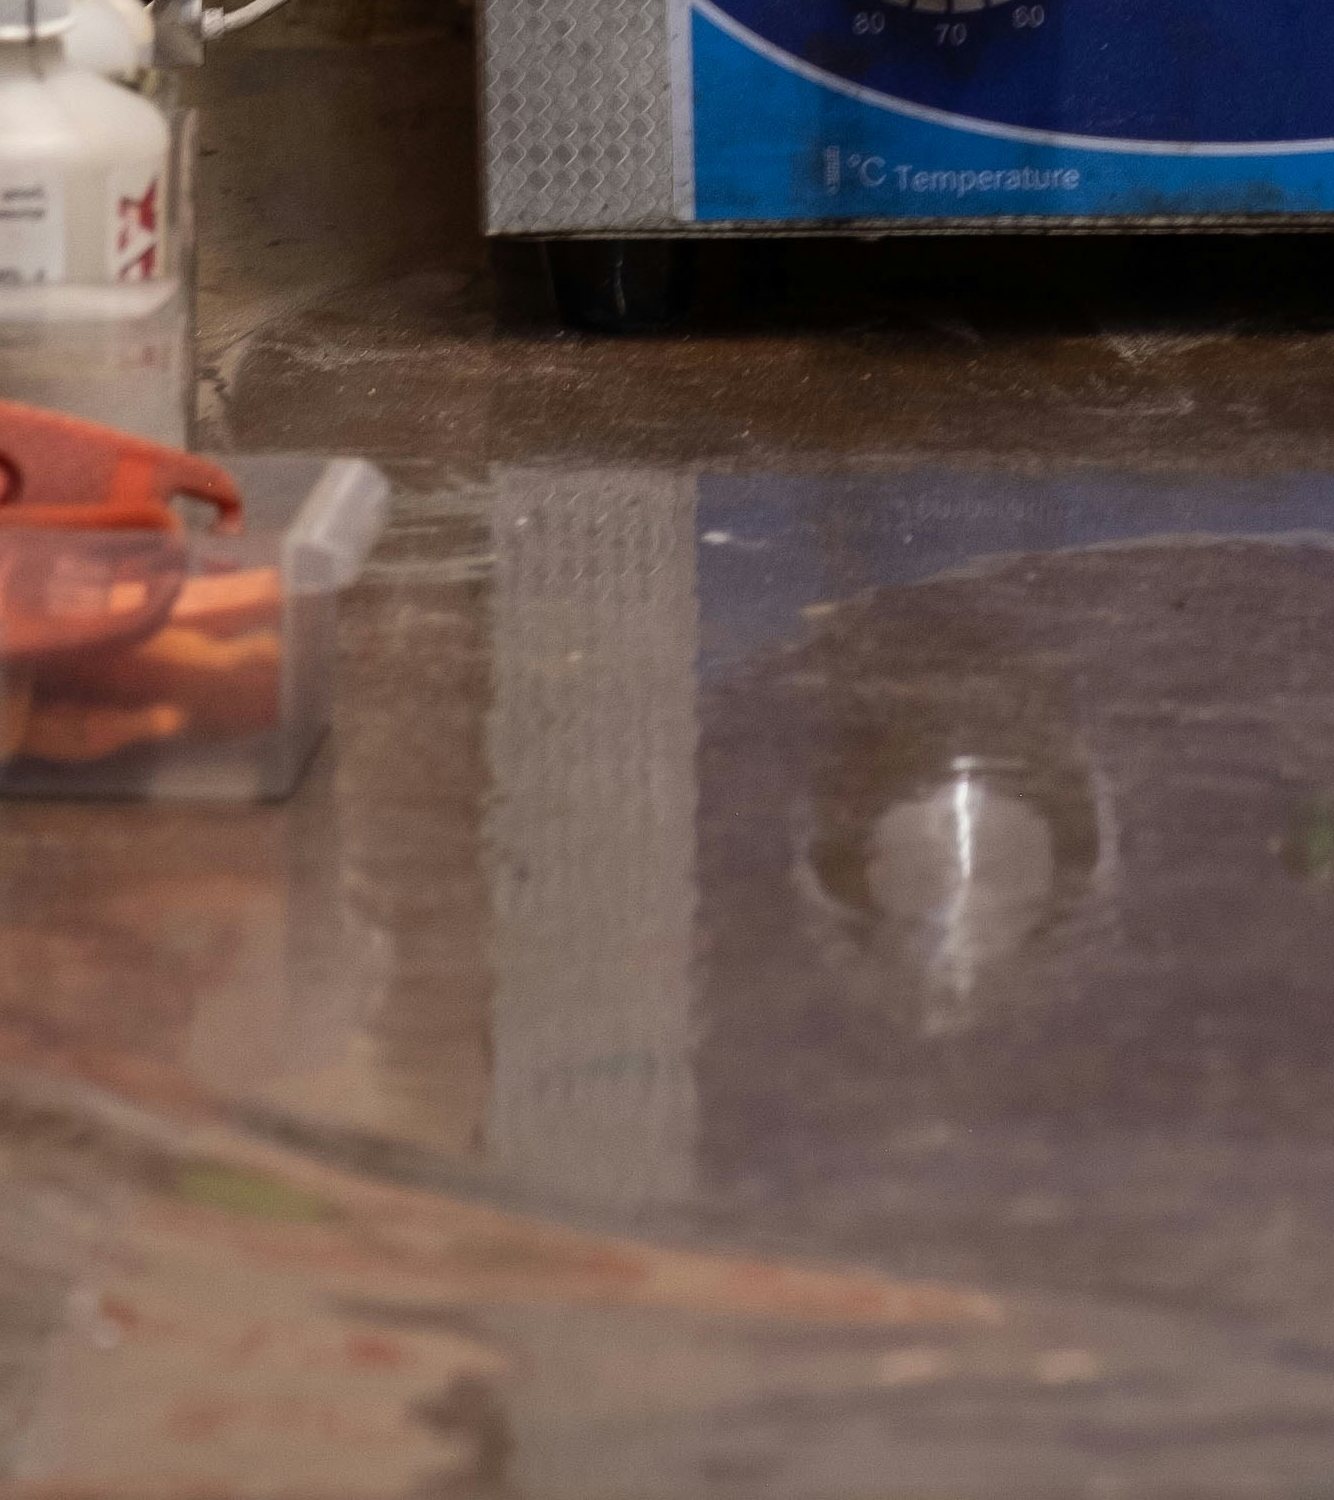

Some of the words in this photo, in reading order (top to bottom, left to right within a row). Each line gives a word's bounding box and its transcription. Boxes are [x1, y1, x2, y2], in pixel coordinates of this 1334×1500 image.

[851, 9, 886, 35] 80
[1011, 4, 1046, 29] 60
[933, 22, 968, 47] 70
[892, 162, 1082, 198] Temperature
